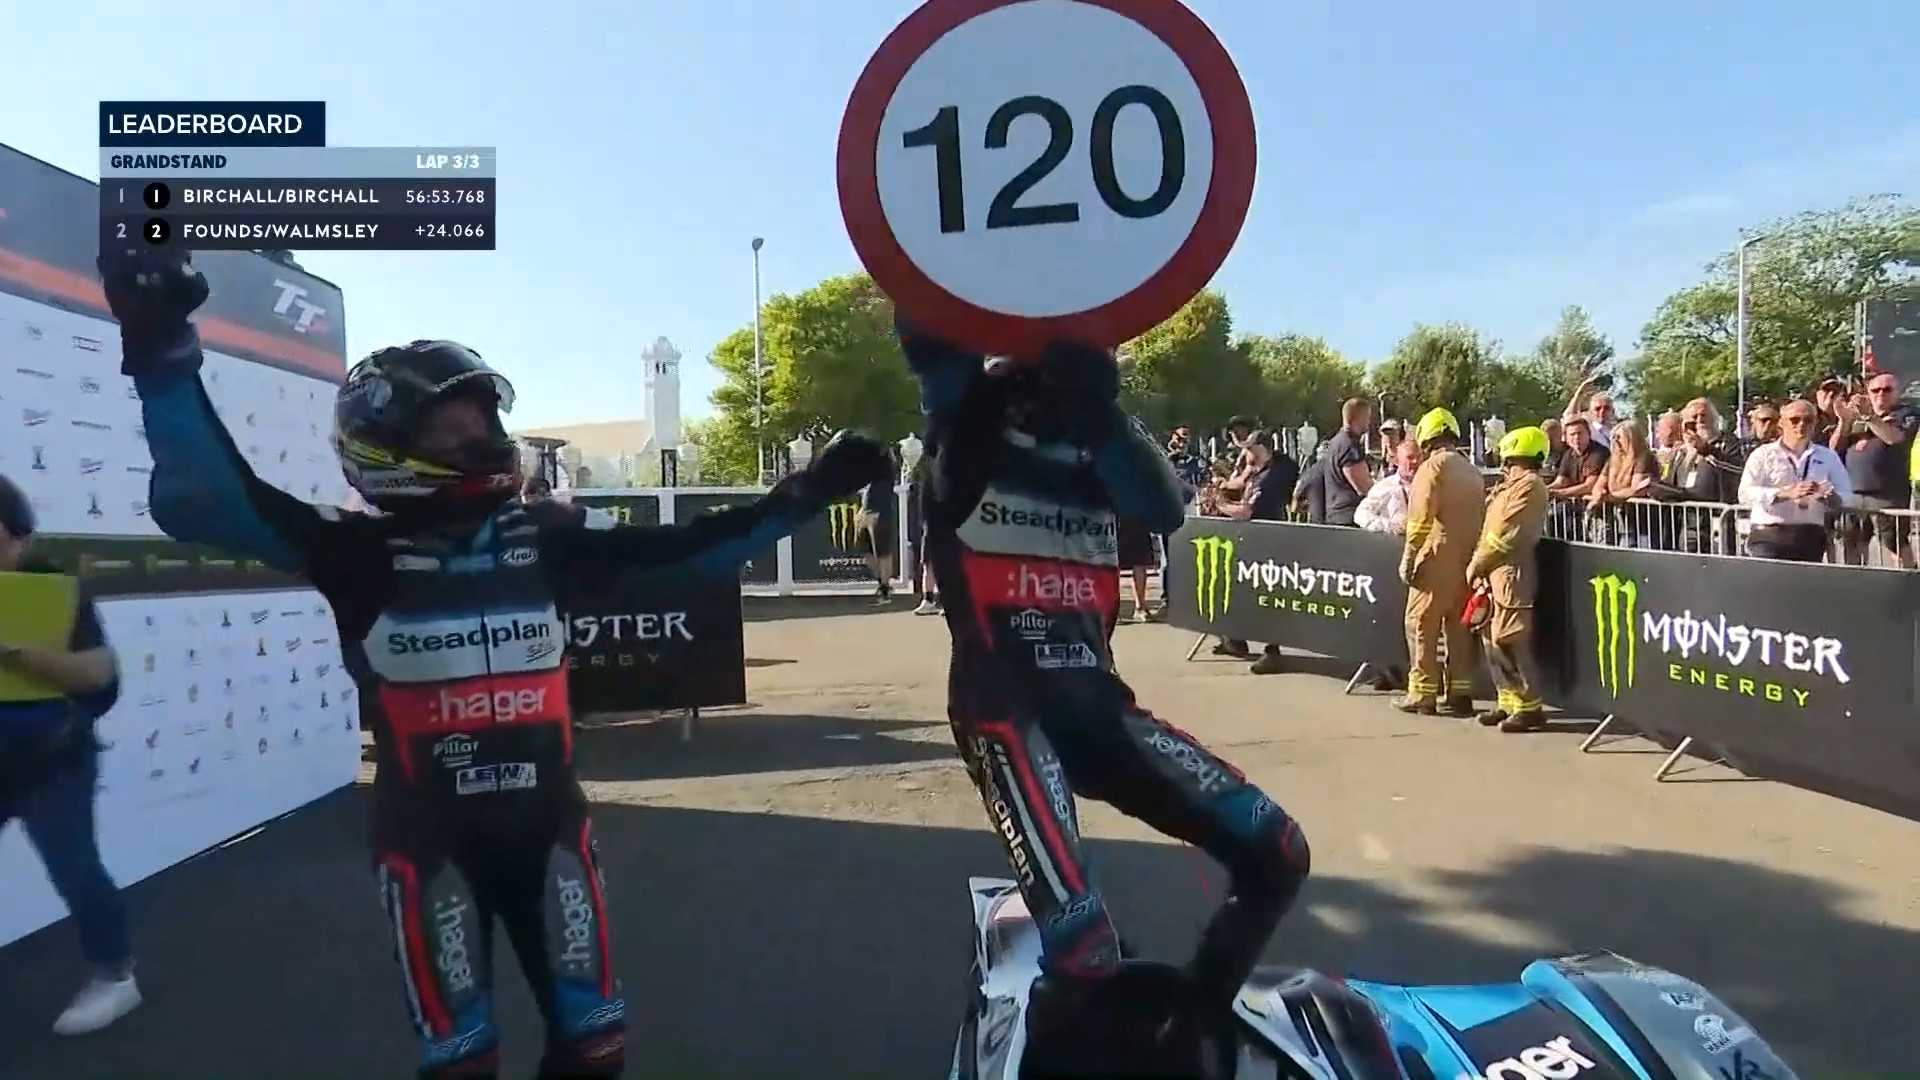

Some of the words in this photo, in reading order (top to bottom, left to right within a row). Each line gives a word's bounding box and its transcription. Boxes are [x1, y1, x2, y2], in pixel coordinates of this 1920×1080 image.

[903, 85, 1185, 234] 120
[273, 279, 326, 333] TT
[980, 502, 1116, 538] Steadplan
[1237, 558, 1376, 603] MONSTER
[1259, 595, 1352, 619] ENERGY
[388, 619, 551, 655] Steadplan
[1642, 610, 1850, 684] MONSTER
[429, 686, 547, 723] :hager
[1669, 664, 1810, 708] ENERGY
